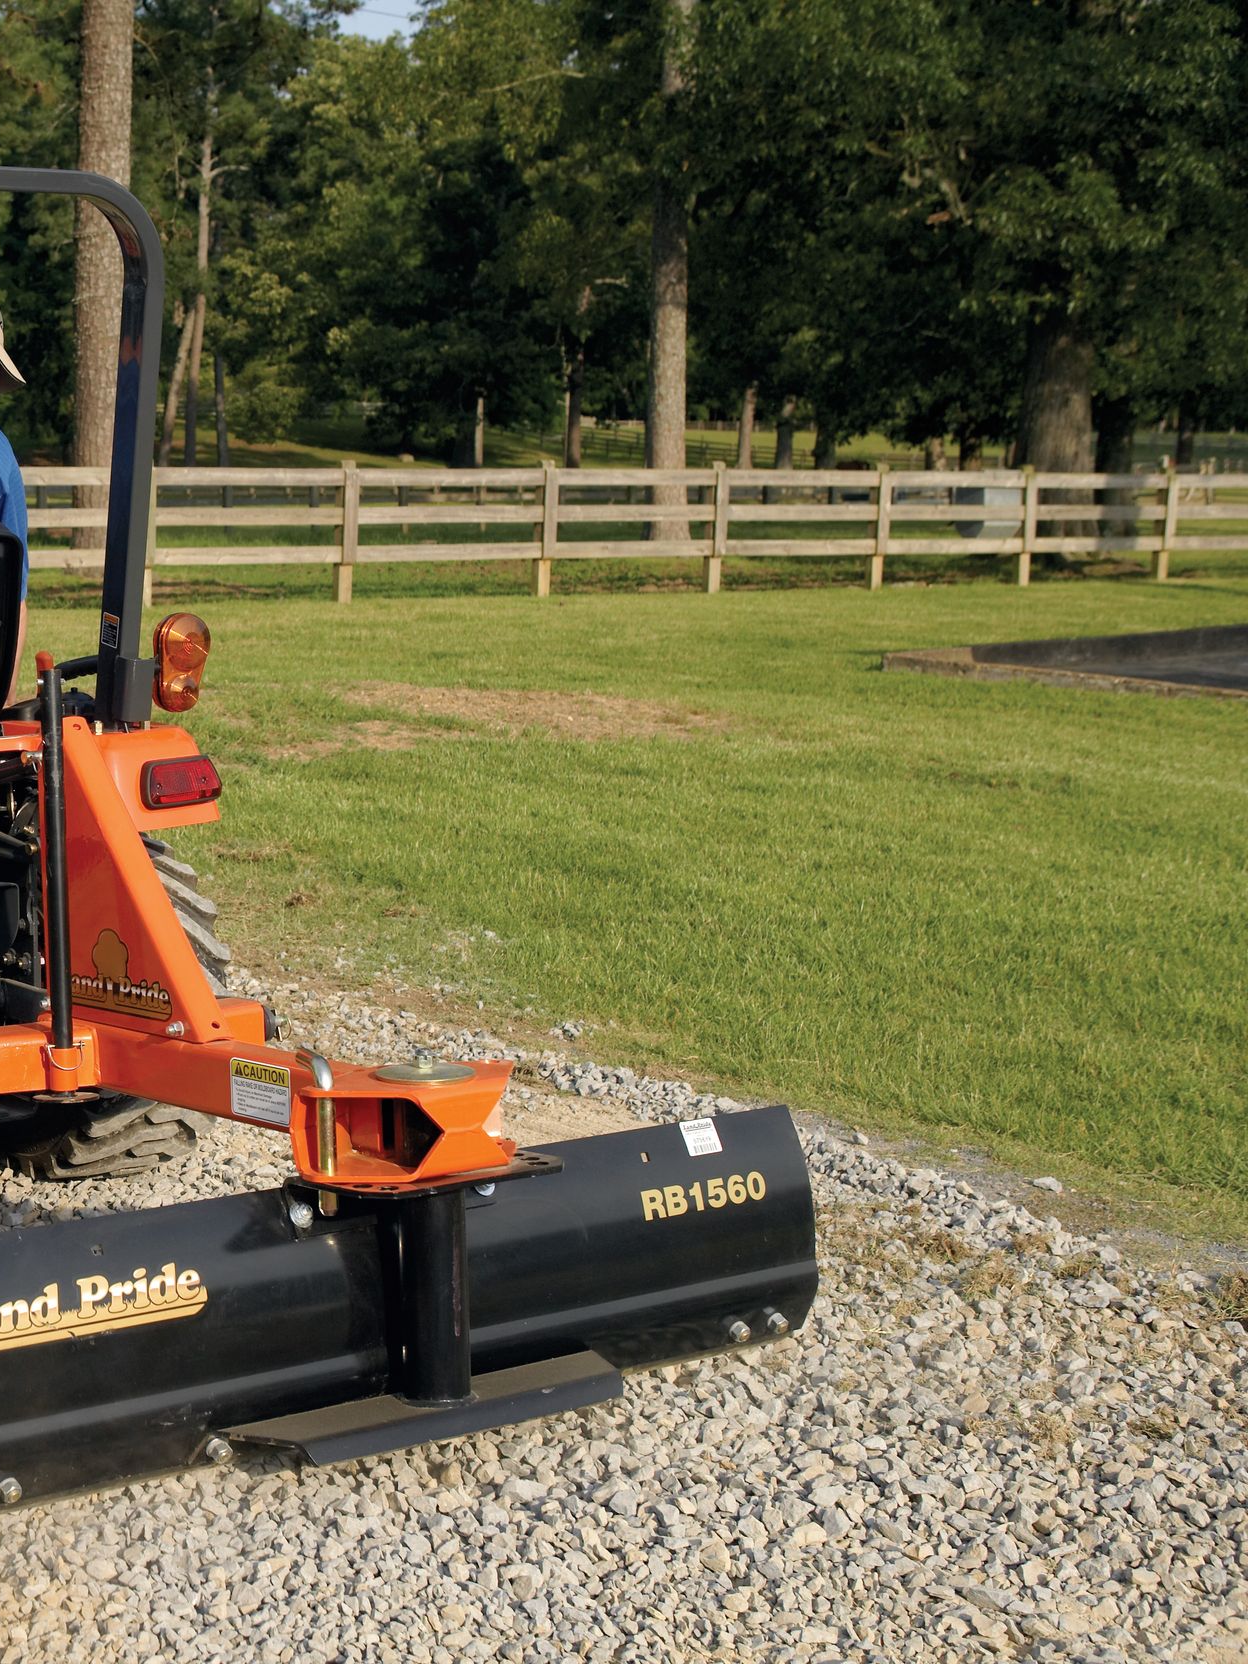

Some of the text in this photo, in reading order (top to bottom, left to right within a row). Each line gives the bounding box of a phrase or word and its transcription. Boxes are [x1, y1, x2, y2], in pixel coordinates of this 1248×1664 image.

[71, 974, 170, 1010] and Pride
[242, 1064, 285, 1085] CAUTION
[640, 1171, 766, 1221] RB1560
[76, 1262, 201, 1319] Pride
